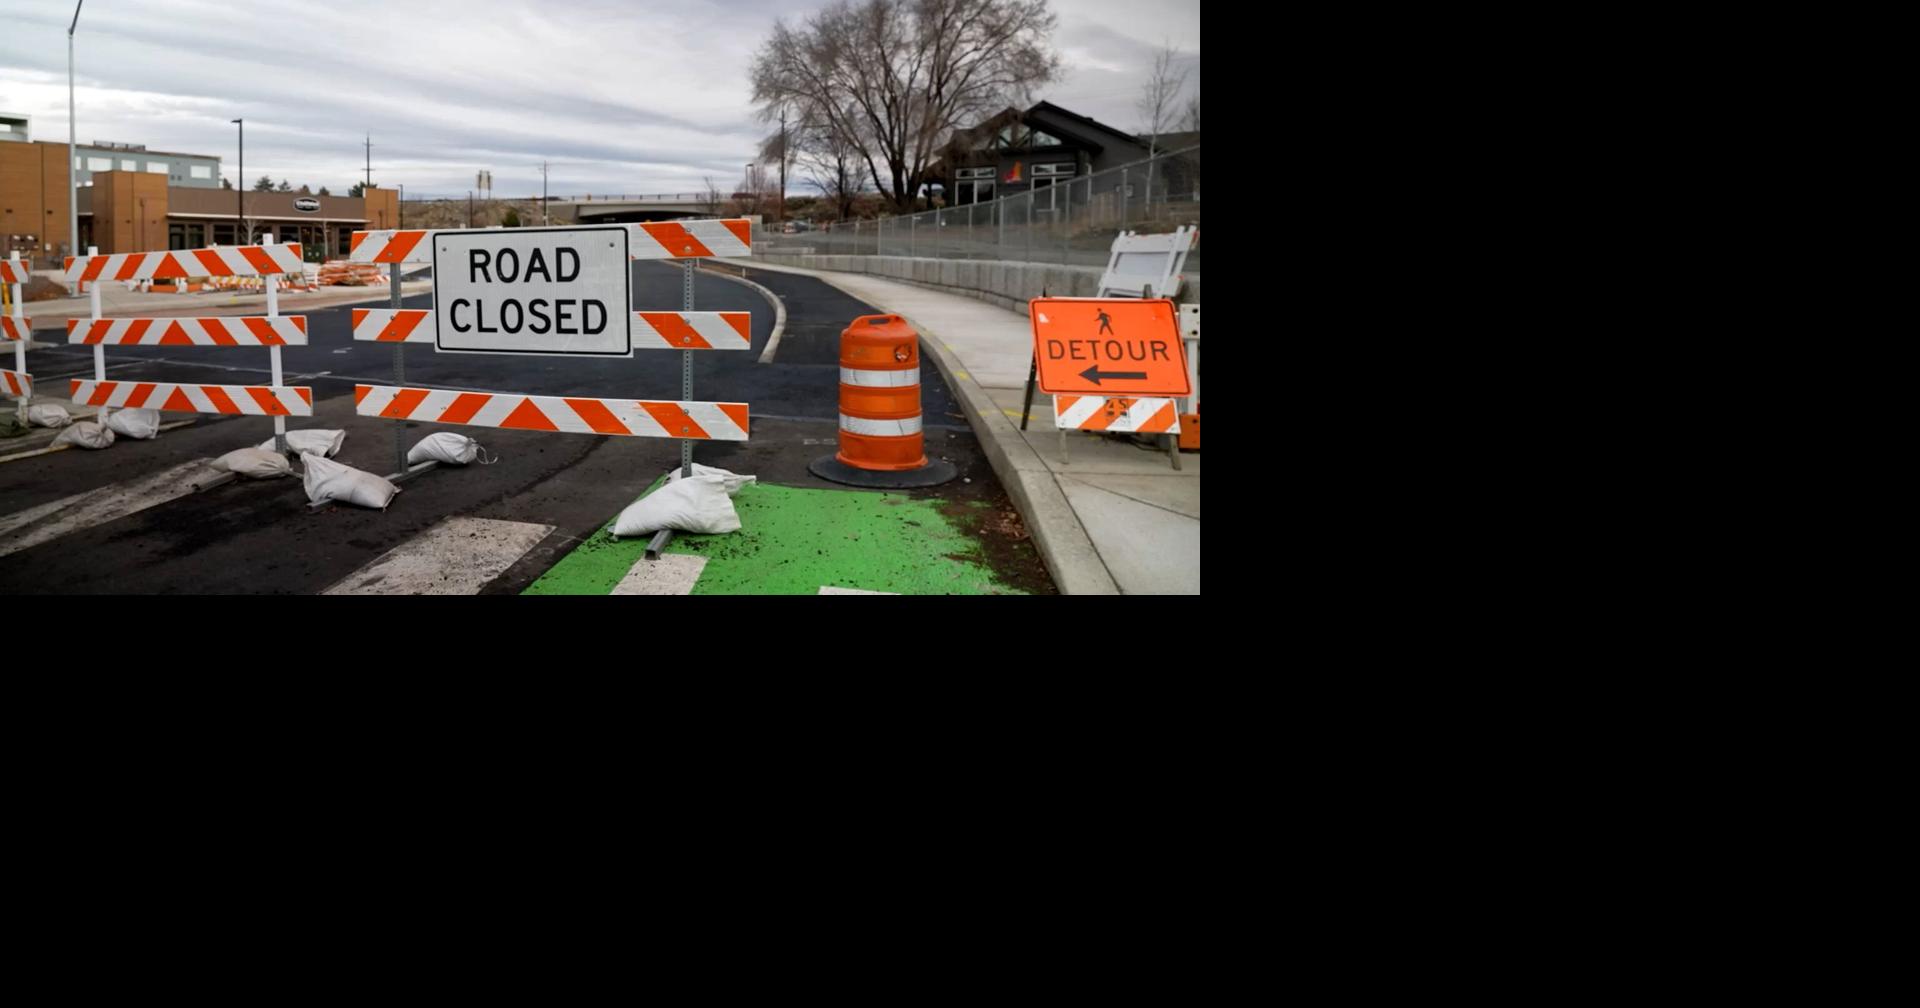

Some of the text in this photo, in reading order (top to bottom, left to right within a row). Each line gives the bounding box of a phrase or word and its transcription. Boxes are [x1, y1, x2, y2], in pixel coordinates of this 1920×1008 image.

[469, 246, 581, 284] ROAD
[449, 298, 608, 335] CLOSED
[1047, 339, 1171, 362] DETOUR
